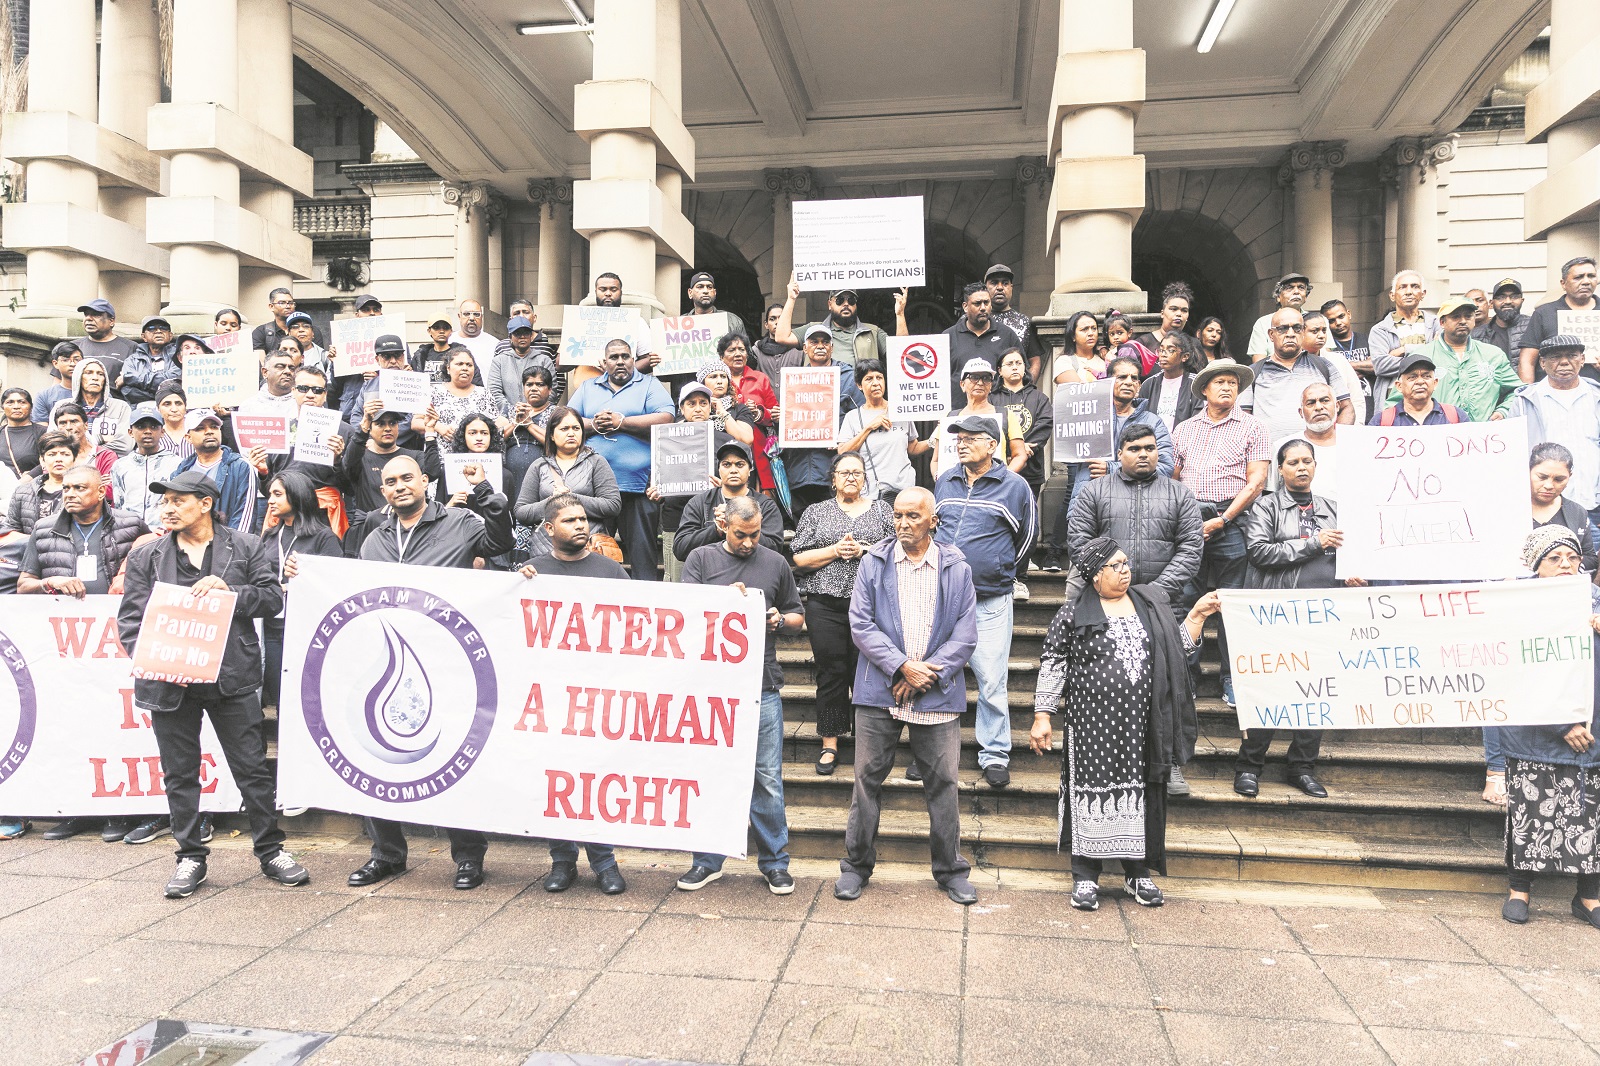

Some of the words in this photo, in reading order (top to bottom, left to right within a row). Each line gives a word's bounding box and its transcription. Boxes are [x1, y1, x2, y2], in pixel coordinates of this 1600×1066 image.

[796, 272, 818, 281] EAT
[822, 270, 844, 280] THE
[848, 267, 924, 279] POLITICIANS!
[579, 307, 628, 322] WATER
[338, 317, 385, 330] WATER
[586, 321, 607, 334] IS
[663, 316, 695, 331] NO
[1563, 326, 1600, 335] MORE
[340, 330, 358, 341] IS
[364, 328, 374, 340] A
[666, 328, 712, 345] MORE
[346, 340, 376, 354] HUM
[580, 336, 611, 350] LIF
[350, 354, 376, 367] RIG
[656, 359, 690, 373] WATER
[187, 368, 236, 376] DELIVERY
[789, 374, 800, 385] NO
[802, 373, 830, 384] HUMAN
[916, 382, 940, 390] WILL
[1070, 383, 1096, 395] STOP
[795, 392, 824, 403] RIGHTS
[792, 410, 808, 422] DAY
[810, 410, 826, 421] FOR
[897, 404, 945, 414] SILENCED
[668, 426, 694, 437] MAYOR
[788, 428, 830, 440] RESIDENTS
[1076, 442, 1090, 456] US
[1374, 437, 1425, 459] 230
[1446, 434, 1506, 457] DAYS
[666, 454, 698, 465] BETRAYS
[1249, 599, 1340, 625] WATER
[1368, 595, 1397, 619] IS
[1420, 590, 1485, 617] LIFE
[154, 613, 218, 642] Paying
[312, 590, 410, 650] VERULAM
[423, 596, 487, 661] WATER
[520, 598, 686, 660] WATER
[700, 610, 749, 664] IS
[1350, 627, 1380, 640] AND
[149, 641, 182, 662] For
[185, 646, 210, 667] No
[1236, 651, 1310, 674] CLEAN
[1339, 646, 1421, 670] WATER
[1440, 642, 1508, 668] MEANS
[1521, 635, 1591, 664] HEALTH
[1296, 677, 1338, 698] WE
[1384, 673, 1485, 697] DEMAND
[514, 683, 548, 733] A
[562, 686, 740, 747] HUMAN
[1256, 702, 1333, 727] WATER
[1355, 704, 1374, 725] IN
[1394, 703, 1434, 725] OUR
[1454, 699, 1508, 722] TAPS
[320, 736, 370, 790] CRISIS
[375, 745, 478, 800] COMMITTEE
[543, 770, 700, 829] RIGHT
